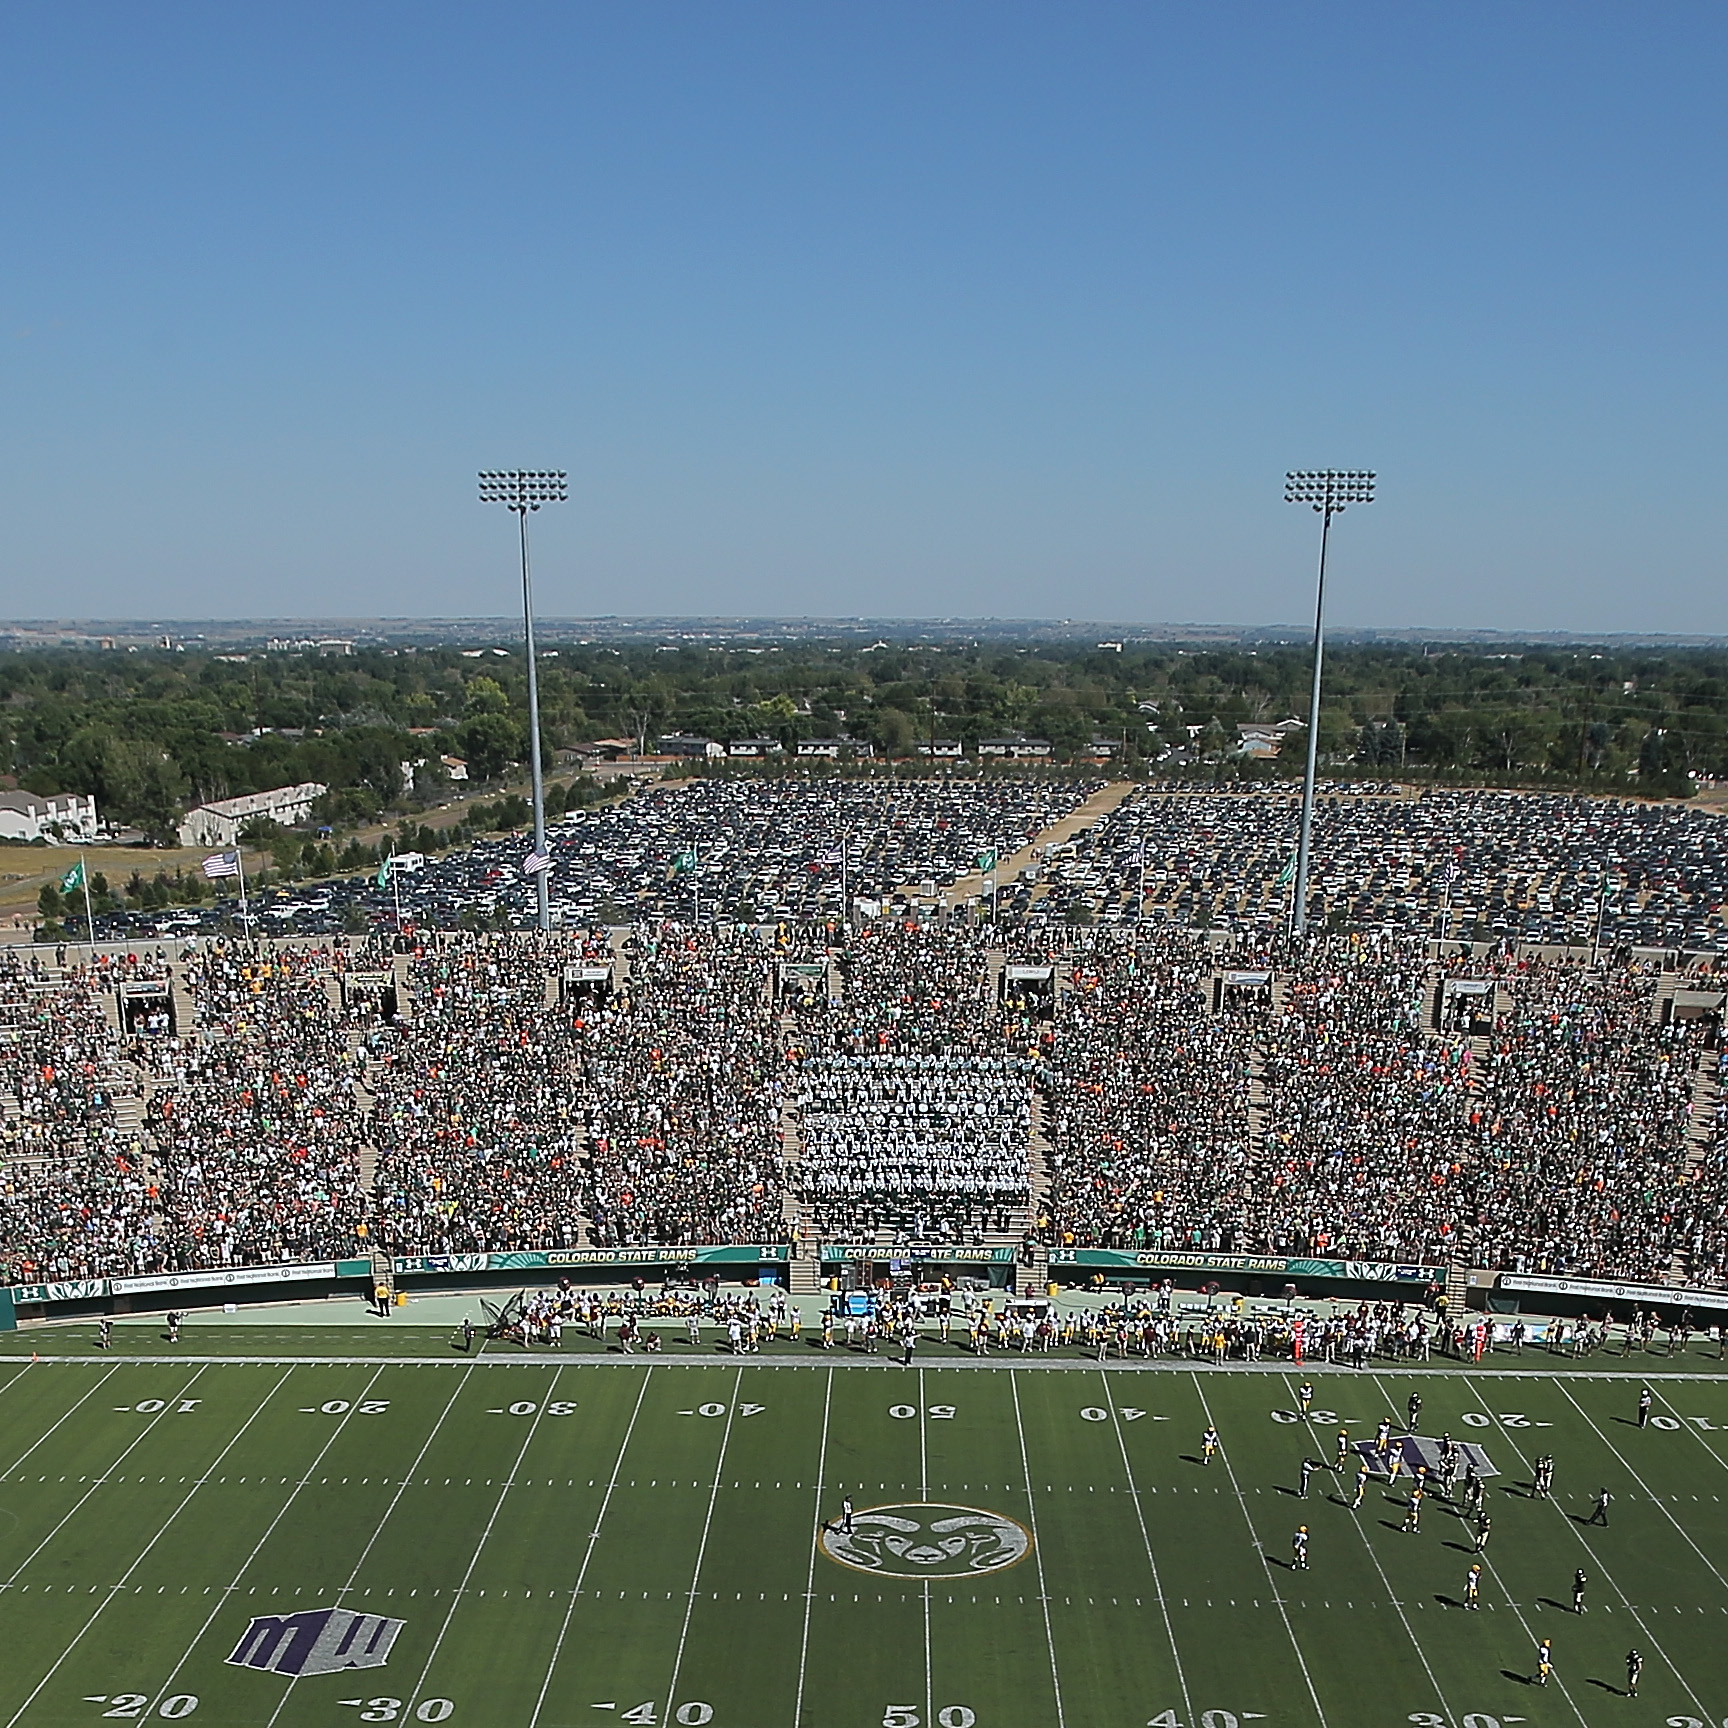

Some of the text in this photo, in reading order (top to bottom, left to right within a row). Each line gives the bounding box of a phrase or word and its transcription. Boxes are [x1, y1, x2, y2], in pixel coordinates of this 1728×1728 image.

[547, 1248, 697, 1264] COLORADO STATE RAMS
[844, 1248, 910, 1260] COLORADO
[955, 1249, 993, 1260] RAMS
[1136, 1253, 1288, 1271] COLORADO STATE RAMS
[136, 1398, 203, 1414] 10
[320, 1398, 391, 1415] 20
[509, 1400, 578, 1416] 30
[697, 1402, 766, 1418] 40
[888, 1404, 957, 1420] 50
[1080, 1406, 1147, 1422] 40
[1461, 1412, 1532, 1428] 20
[1650, 1415, 1720, 1432] 10
[102, 1693, 200, 1720] 20
[359, 1697, 455, 1723] 30
[621, 1701, 714, 1726] 40
